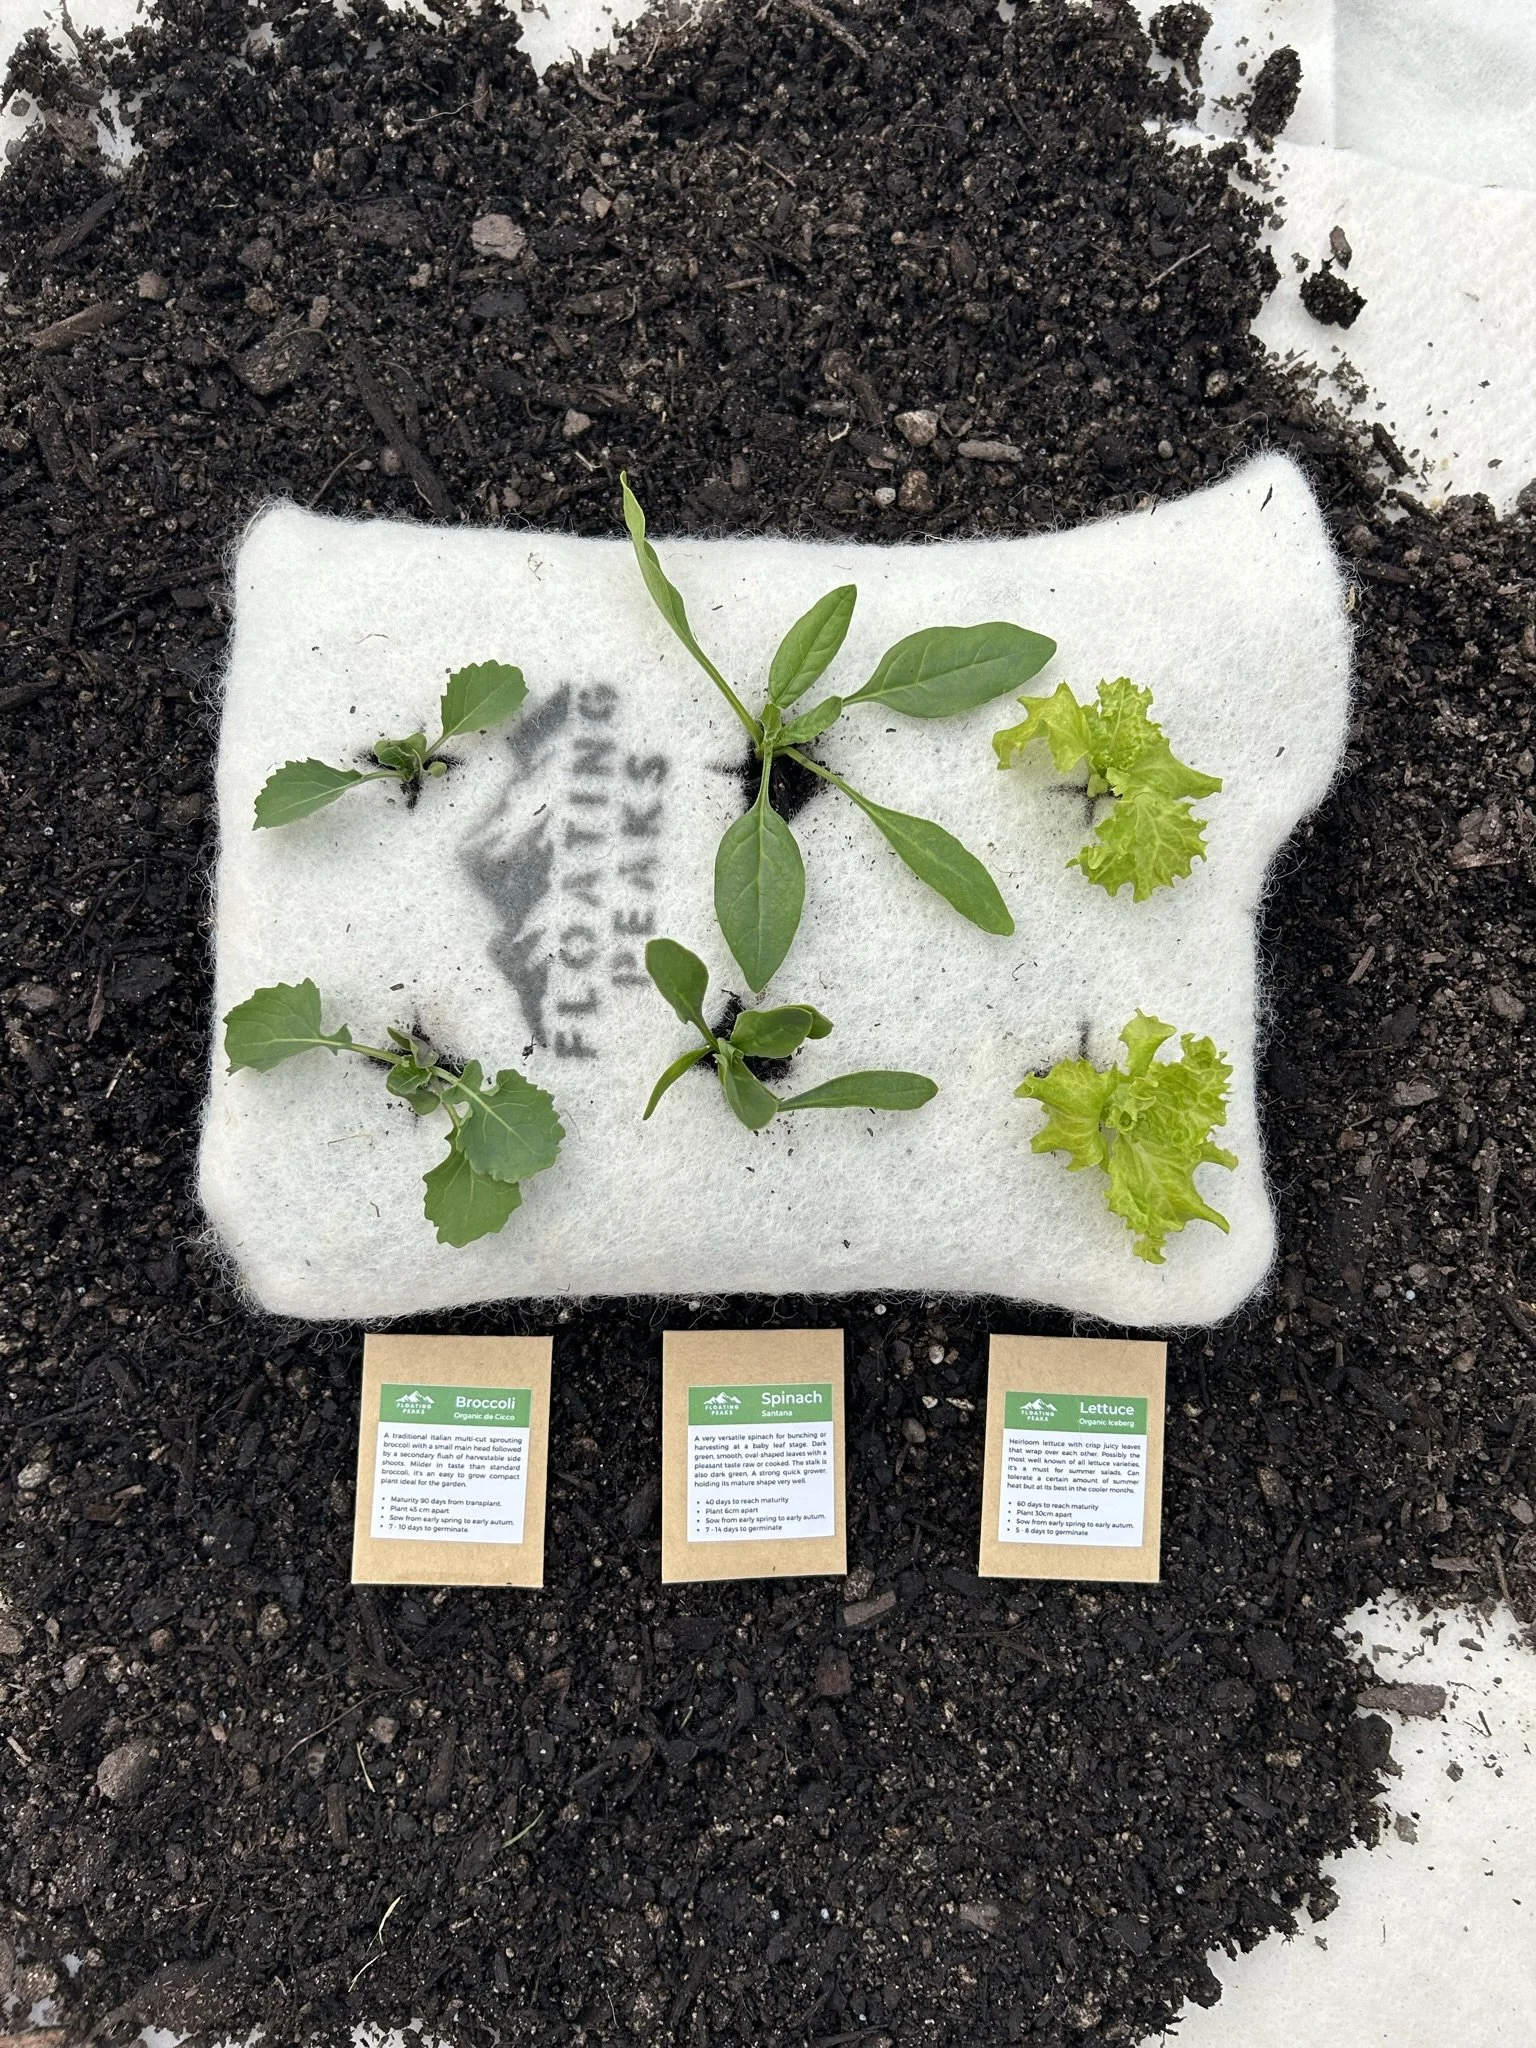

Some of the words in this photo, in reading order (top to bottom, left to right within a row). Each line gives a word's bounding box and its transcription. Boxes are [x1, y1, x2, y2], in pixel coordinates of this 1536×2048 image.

[553, 682, 619, 1059] FLOATING
[610, 753, 669, 989] PEAKS
[455, 1396, 516, 1409] Broccoli
[762, 1390, 822, 1407] Spinach
[1080, 1402, 1134, 1416] Lettuce
[453, 1412, 482, 1420] Organic
[1079, 1418, 1106, 1426] Organic
[1108, 1419, 1135, 1428] Iceberg
[489, 1437, 522, 1445] sprouting
[748, 1433, 774, 1441] spinach
[1009, 1438, 1040, 1446] Heirloom
[1103, 1442, 1119, 1450] juicy
[400, 1452, 434, 1460] secondary
[1102, 1451, 1127, 1459] Possibly
[782, 1469, 801, 1477] quick
[391, 1496, 419, 1504] Maturity
[430, 1498, 446, 1506] days
[715, 1498, 731, 1506] days
[761, 1496, 789, 1504] maturity
[1027, 1501, 1042, 1509] days
[441, 1517, 462, 1525] spring
[739, 1516, 755, 1524] early
[786, 1514, 802, 1522] early
[407, 1524, 423, 1532] days
[723, 1526, 739, 1534] days
[748, 1525, 782, 1533] germinate
